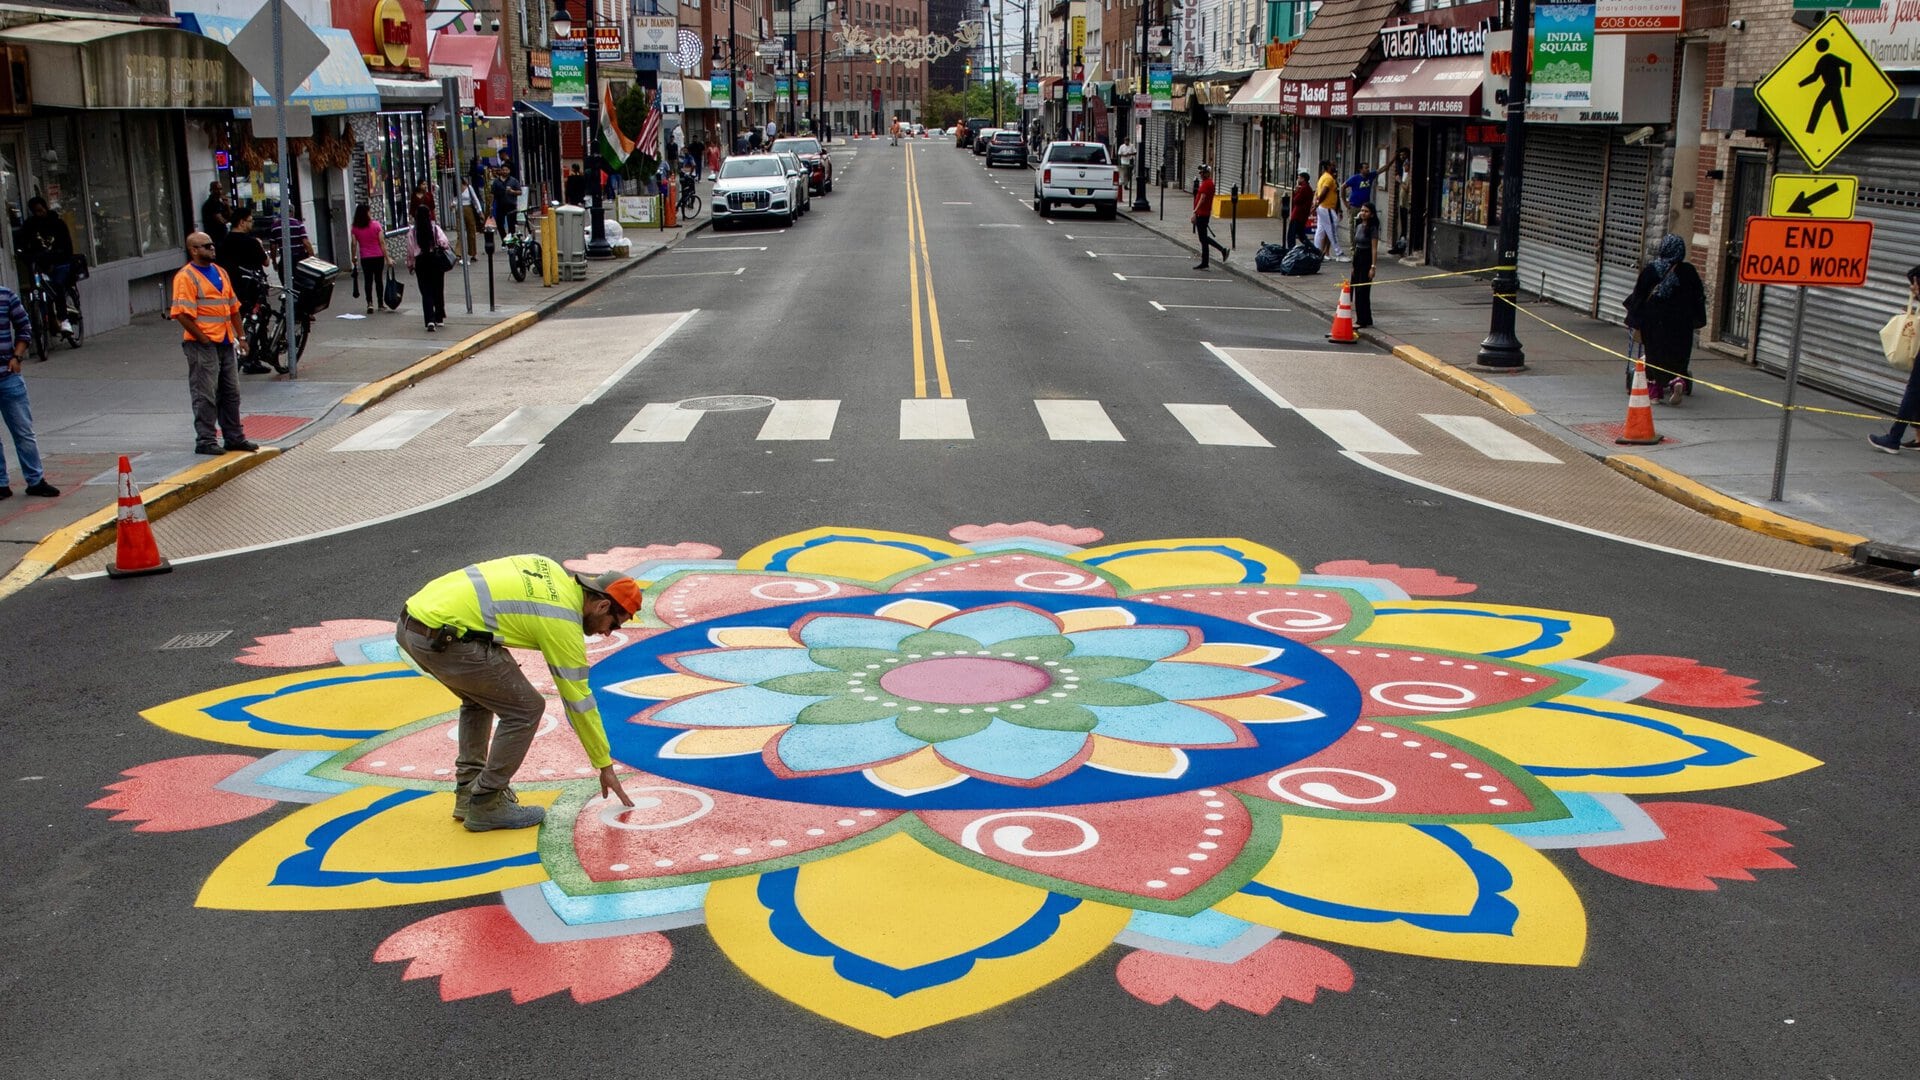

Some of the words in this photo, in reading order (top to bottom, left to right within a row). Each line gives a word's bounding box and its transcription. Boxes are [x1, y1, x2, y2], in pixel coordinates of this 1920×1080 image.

[636, 18, 648, 28] TAJ
[650, 18, 675, 28] DIAMOND
[1601, 17, 1624, 28] 608
[1628, 17, 1662, 28] 0666
[1547, 32, 1582, 42] INDIA
[1539, 42, 1588, 53] SQUARE
[1870, 38, 1910, 61] Diamond
[1300, 82, 1328, 102] Rasoi
[1418, 101, 1463, 112] 201.418.9669
[1785, 226, 1834, 249] END
[1746, 254, 1800, 276] ROAD
[1810, 256, 1862, 278] WORK
